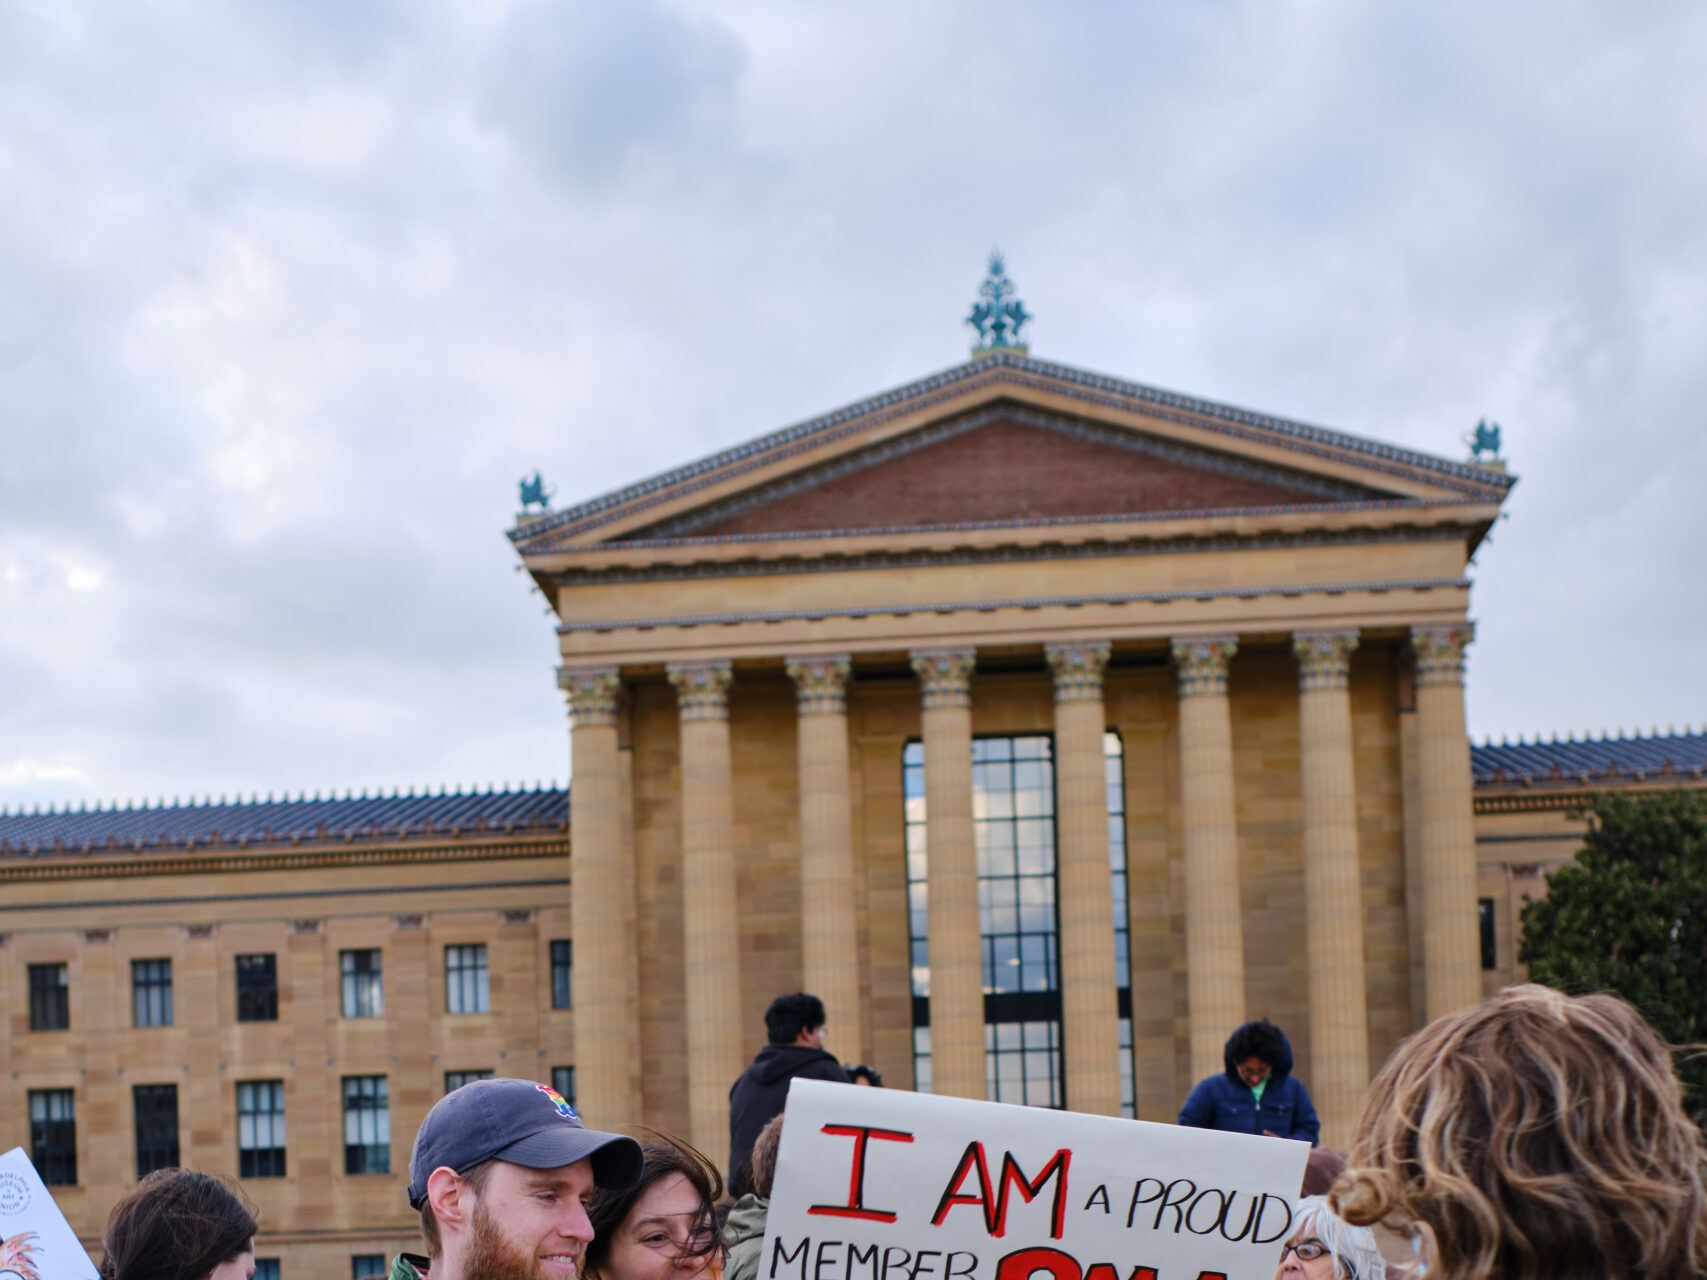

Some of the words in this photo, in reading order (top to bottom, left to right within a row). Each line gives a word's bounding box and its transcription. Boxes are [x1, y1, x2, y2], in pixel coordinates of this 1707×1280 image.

[807, 1123, 914, 1225] I
[931, 1140, 1072, 1239] AM
[1084, 1183, 1112, 1215] A
[1126, 1177, 1292, 1244] PROUD
